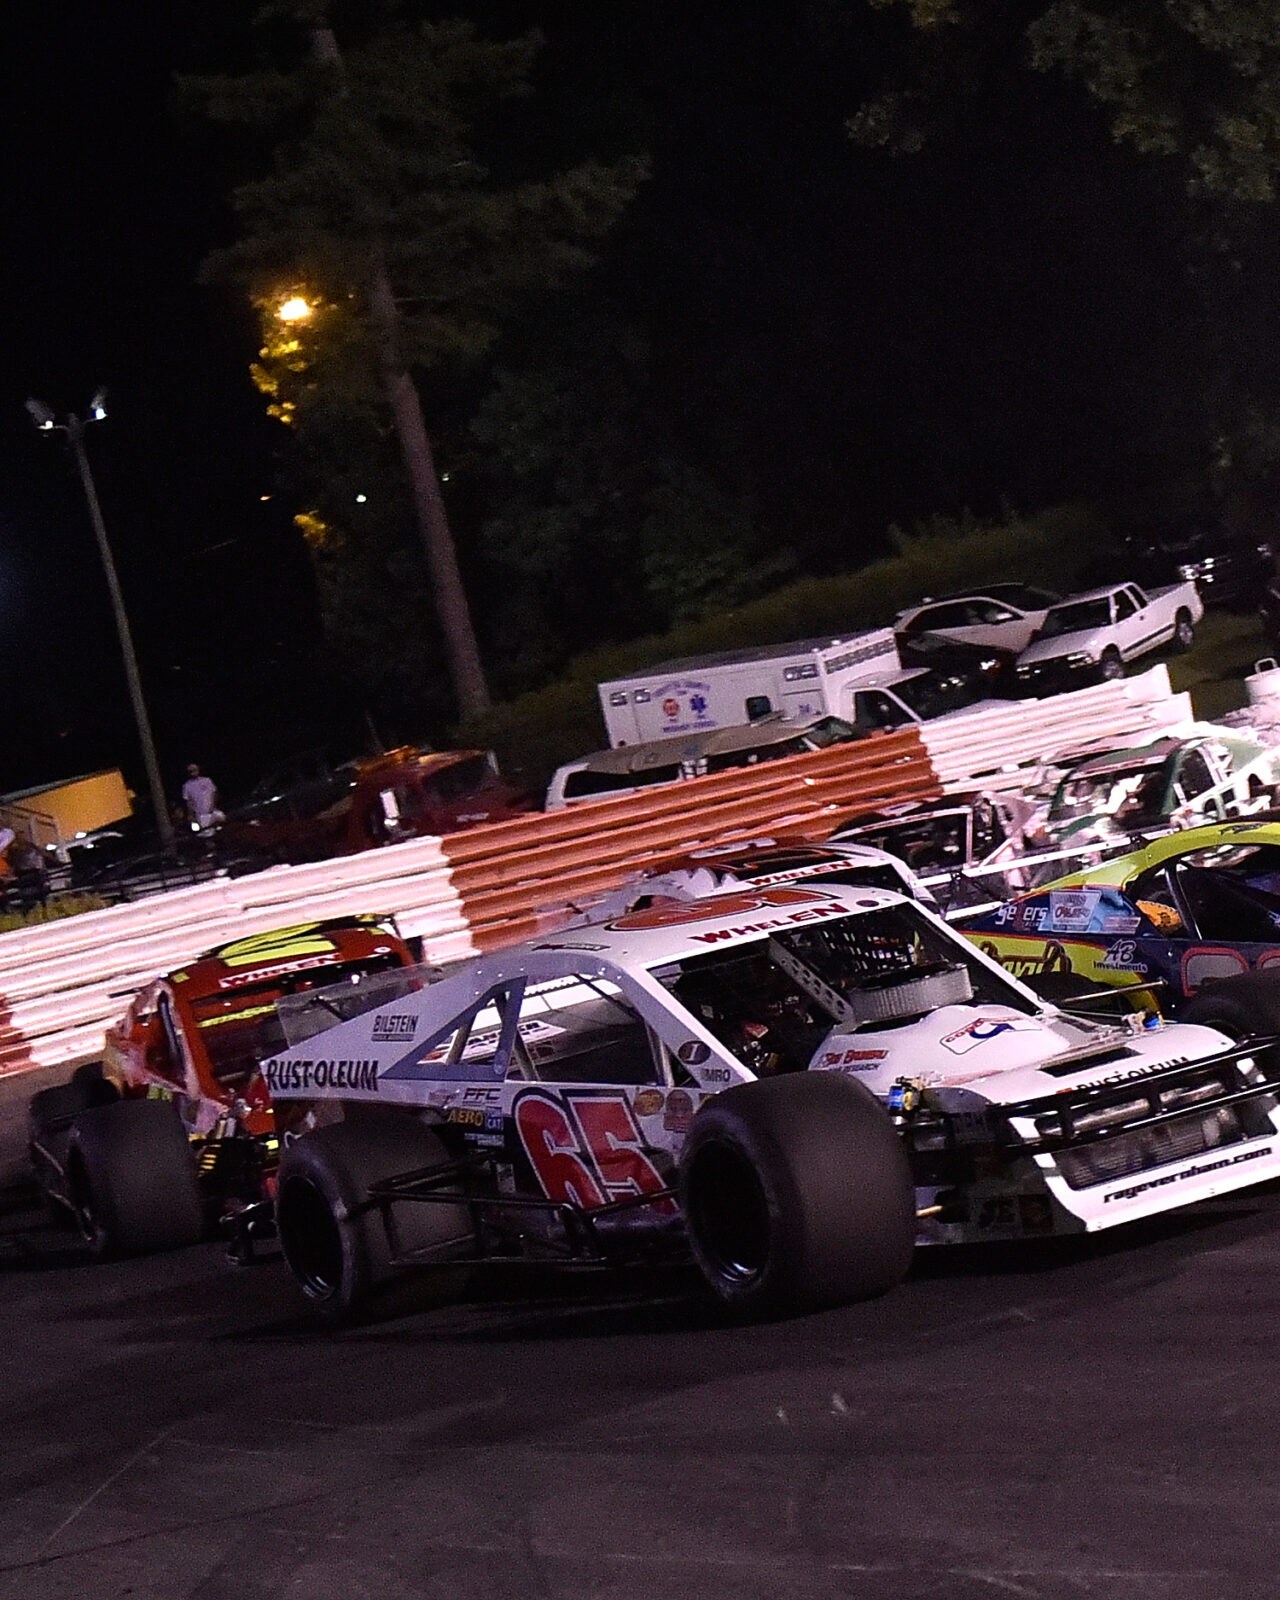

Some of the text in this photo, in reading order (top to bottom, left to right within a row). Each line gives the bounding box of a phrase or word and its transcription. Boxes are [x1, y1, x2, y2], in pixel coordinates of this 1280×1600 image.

[745, 860, 855, 887] WHELEN
[686, 902, 851, 944] WHELEN
[221, 953, 343, 988] WHELEN
[373, 1014, 419, 1033] BILSTEIN
[511, 1086, 680, 1215] 65
